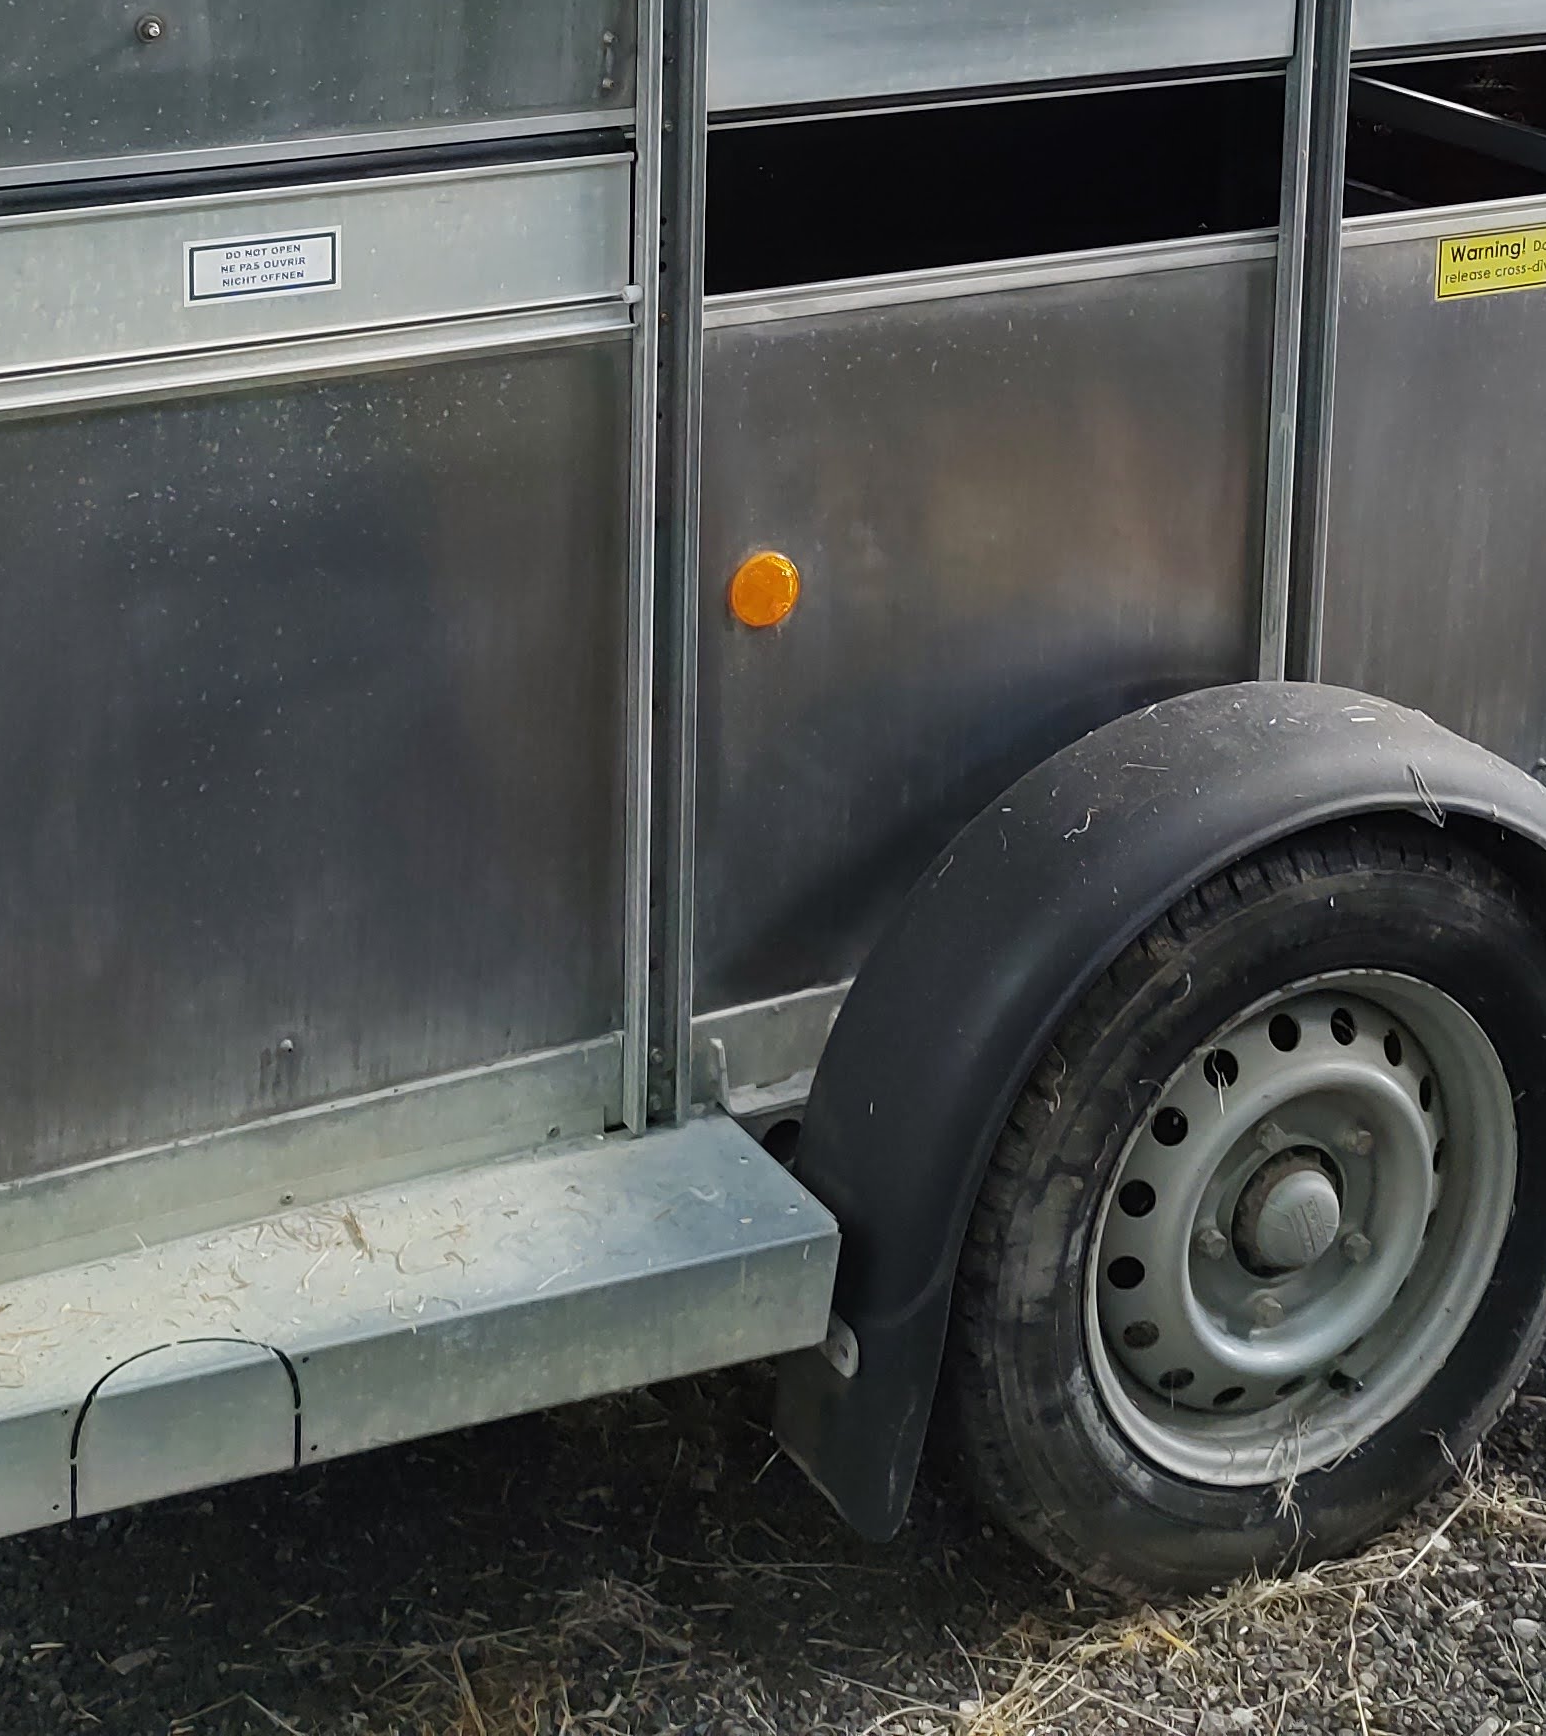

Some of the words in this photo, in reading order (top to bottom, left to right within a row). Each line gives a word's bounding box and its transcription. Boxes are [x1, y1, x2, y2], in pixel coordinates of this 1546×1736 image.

[225, 250, 241, 260] DO
[245, 247, 268, 257] NOT
[271, 244, 301, 254] OPEN
[1450, 236, 1526, 263] Warning!
[220, 264, 236, 274] NE
[239, 261, 260, 272] PAS
[263, 256, 306, 269] OUVRIR
[222, 275, 257, 287] NICHT
[1445, 269, 1491, 284] release
